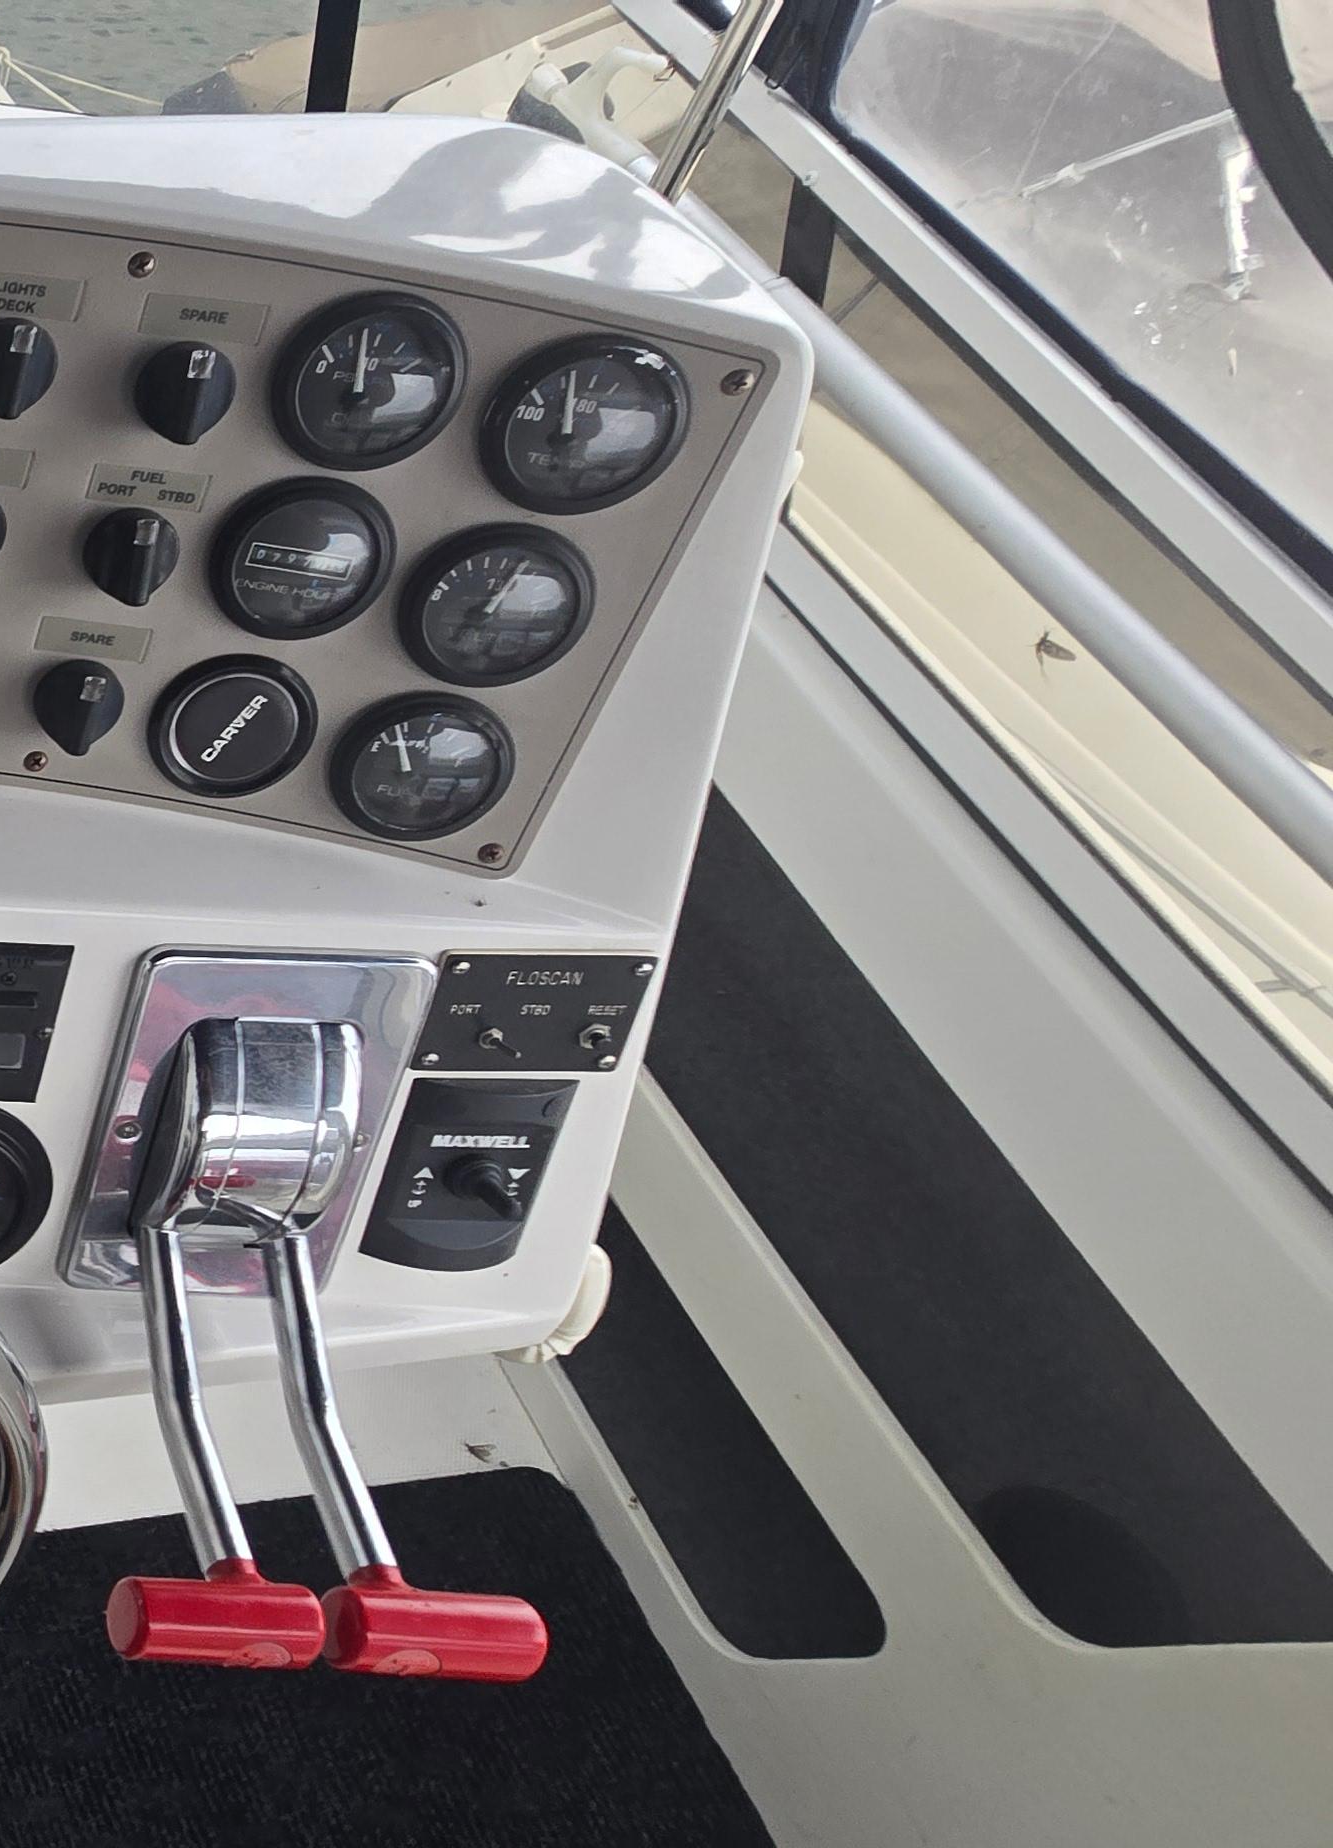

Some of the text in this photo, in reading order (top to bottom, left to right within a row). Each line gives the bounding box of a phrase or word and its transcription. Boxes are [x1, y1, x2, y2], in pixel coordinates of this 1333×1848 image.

[179, 308, 229, 324] SPARE
[316, 360, 327, 373] 0
[364, 357, 379, 371] 0
[333, 371, 355, 382] PS
[516, 405, 545, 421] 100
[527, 452, 586, 469] TEP
[131, 471, 166, 484] FUEL
[97, 482, 196, 504] PORT STBD
[235, 578, 289, 594] ENGINE
[432, 588, 443, 601] 8
[71, 631, 115, 646] SPARE
[201, 695, 268, 764] CARVER
[370, 741, 381, 751] E
[377, 784, 416, 798] FU
[506, 971, 584, 986] FLOSCAN
[449, 1004, 628, 1016] PORT STBD RESET
[430, 1134, 531, 1149] MAXWELL
